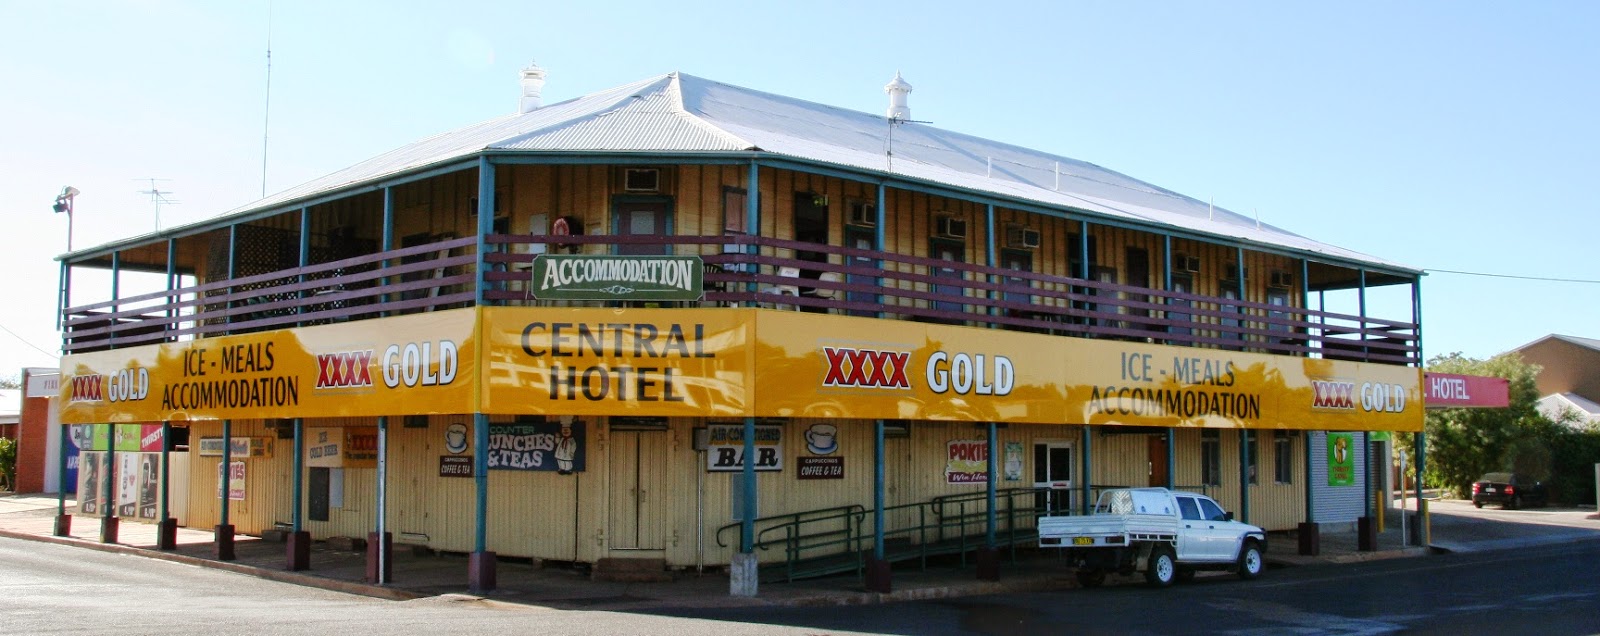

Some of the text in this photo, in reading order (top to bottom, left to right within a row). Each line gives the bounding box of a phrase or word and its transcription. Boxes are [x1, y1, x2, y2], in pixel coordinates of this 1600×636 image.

[541, 258, 693, 291] ACCOMMODATION
[521, 322, 715, 358] CENTRAL
[184, 349, 206, 377] ICE
[221, 341, 274, 374] MEALS
[315, 339, 458, 389] XXXX GOLD
[822, 346, 1015, 396] XXXX GOLD
[1121, 352, 1153, 382] ICE
[1173, 356, 1235, 387] MEALS
[72, 367, 149, 402] XXXX GOLD
[162, 375, 298, 410] ACCOMMODATION
[549, 366, 685, 401] HOTEL
[1312, 380, 1405, 412] XXXX GOLD
[1431, 378, 1470, 400] HOTEL
[1088, 385, 1260, 419] ACCOMMODATION
[142, 426, 164, 449] THIRSTY
[488, 433, 555, 451] UNCHES
[489, 425, 535, 434] COUNTER
[726, 427, 781, 441] CONTIONED
[488, 450, 543, 469] & TEAS
[949, 442, 988, 462] POKIE
[801, 465, 842, 476] COFFEE & TEA
[952, 473, 970, 482] Win
